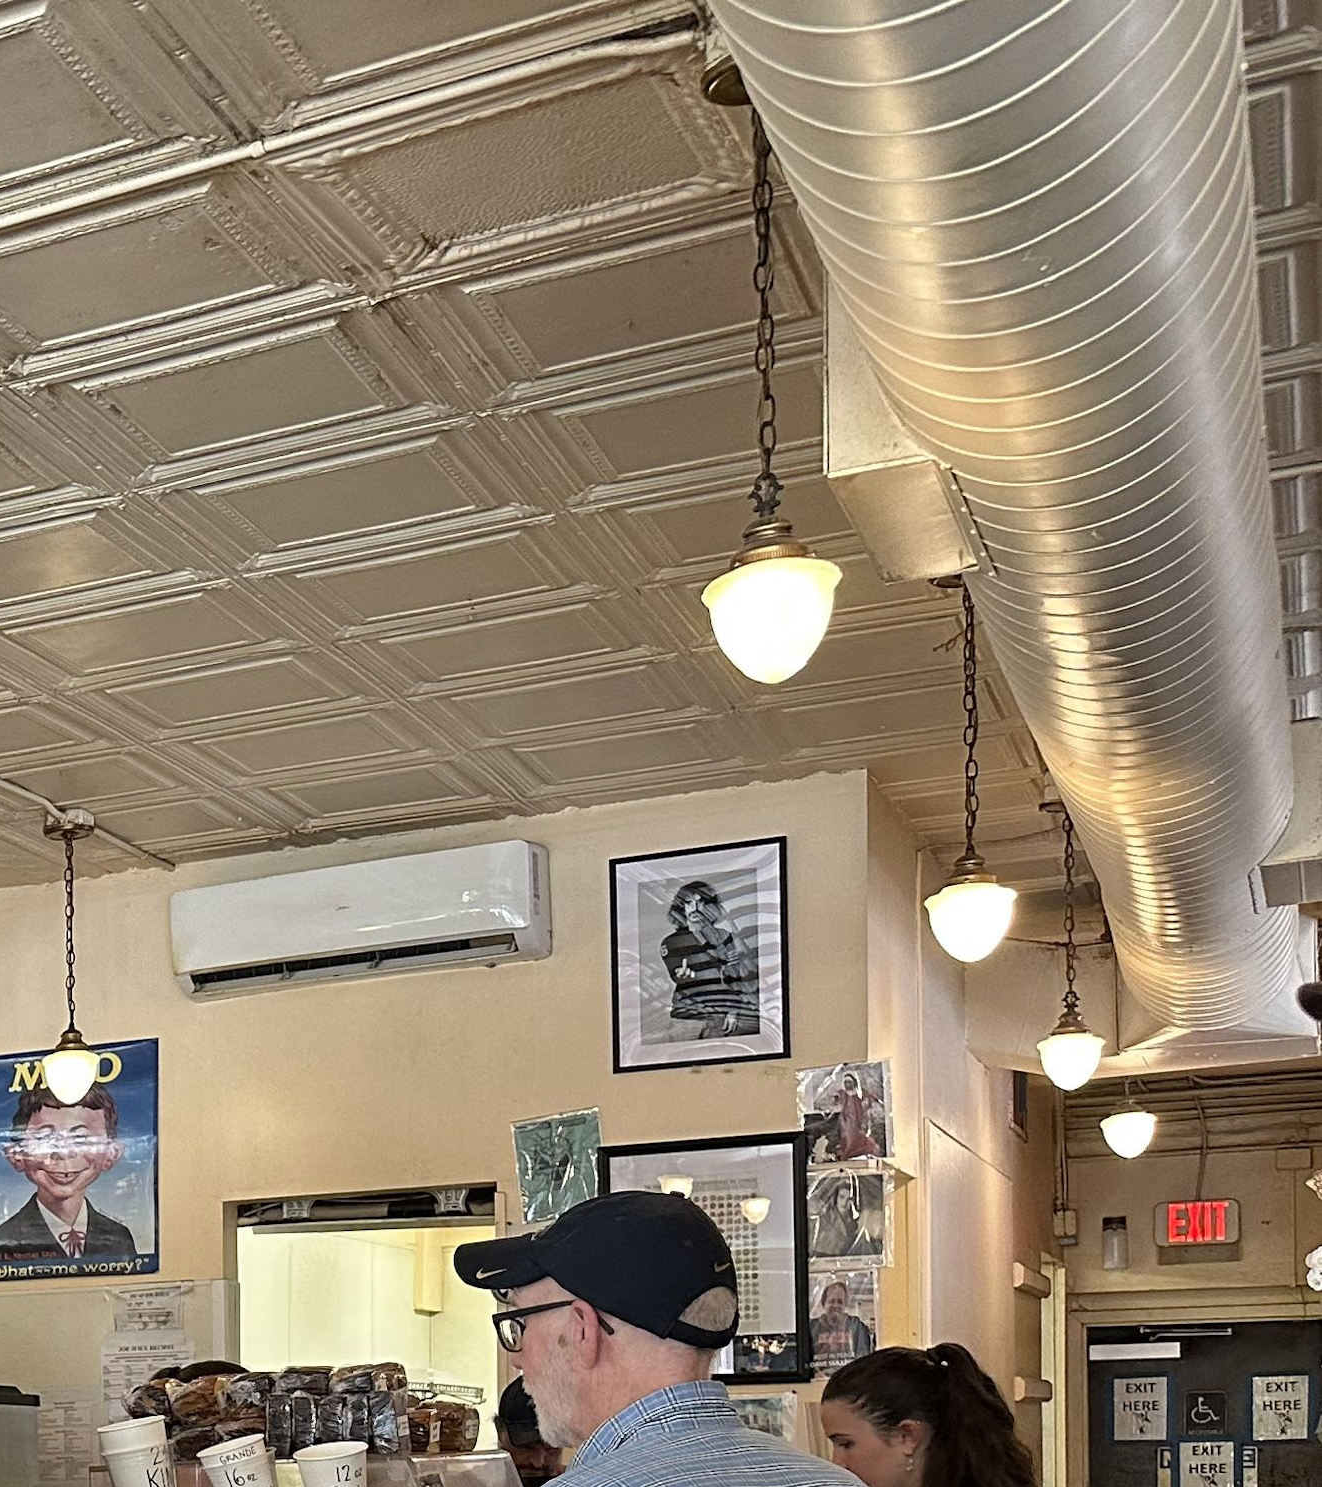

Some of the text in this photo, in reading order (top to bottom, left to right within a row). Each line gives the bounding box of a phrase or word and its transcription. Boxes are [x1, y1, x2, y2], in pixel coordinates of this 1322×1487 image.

[9, 1053, 122, 1092] MD
[1168, 1202, 1229, 1243] EXIT
[1126, 1382, 1156, 1394] EXIT
[1266, 1381, 1297, 1393] EXIT
[1123, 1400, 1160, 1411] HERE
[1263, 1399, 1302, 1411] HERE
[220, 1445, 257, 1465] GRANDE
[1192, 1445, 1222, 1456] EXIT
[336, 1465, 351, 1483] 12
[1189, 1463, 1227, 1475] HERE
